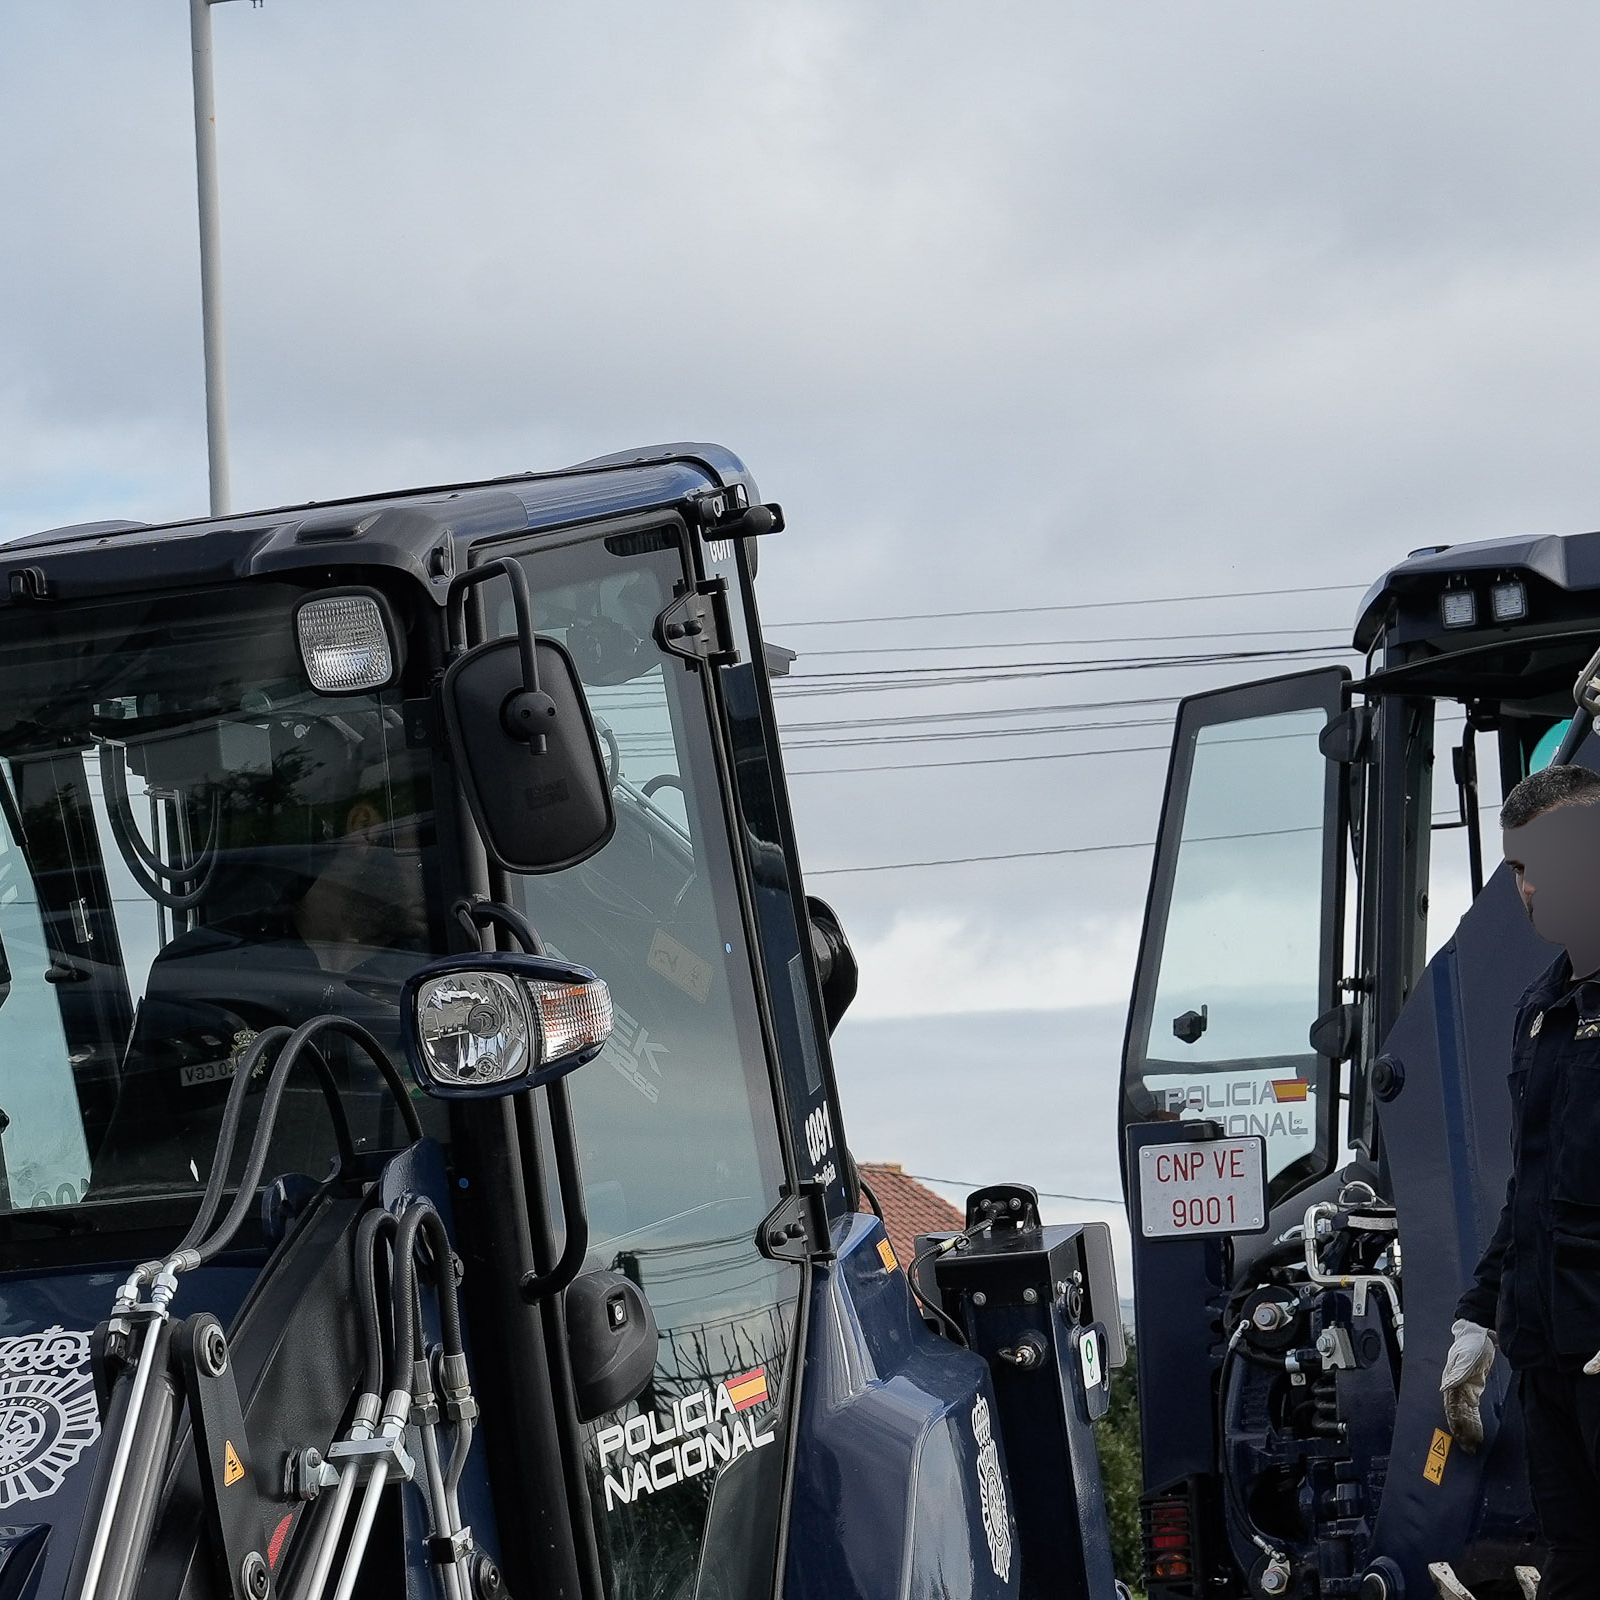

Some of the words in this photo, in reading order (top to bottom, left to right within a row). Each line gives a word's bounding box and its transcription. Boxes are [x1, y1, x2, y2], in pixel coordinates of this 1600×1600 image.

[1206, 1111, 1309, 1137] IONAL
[1156, 1151, 1204, 1183] CNP
[1212, 1149, 1245, 1179] VE
[1172, 1195, 1235, 1228] 9001
[604, 1415, 775, 1511] NACIONAL
